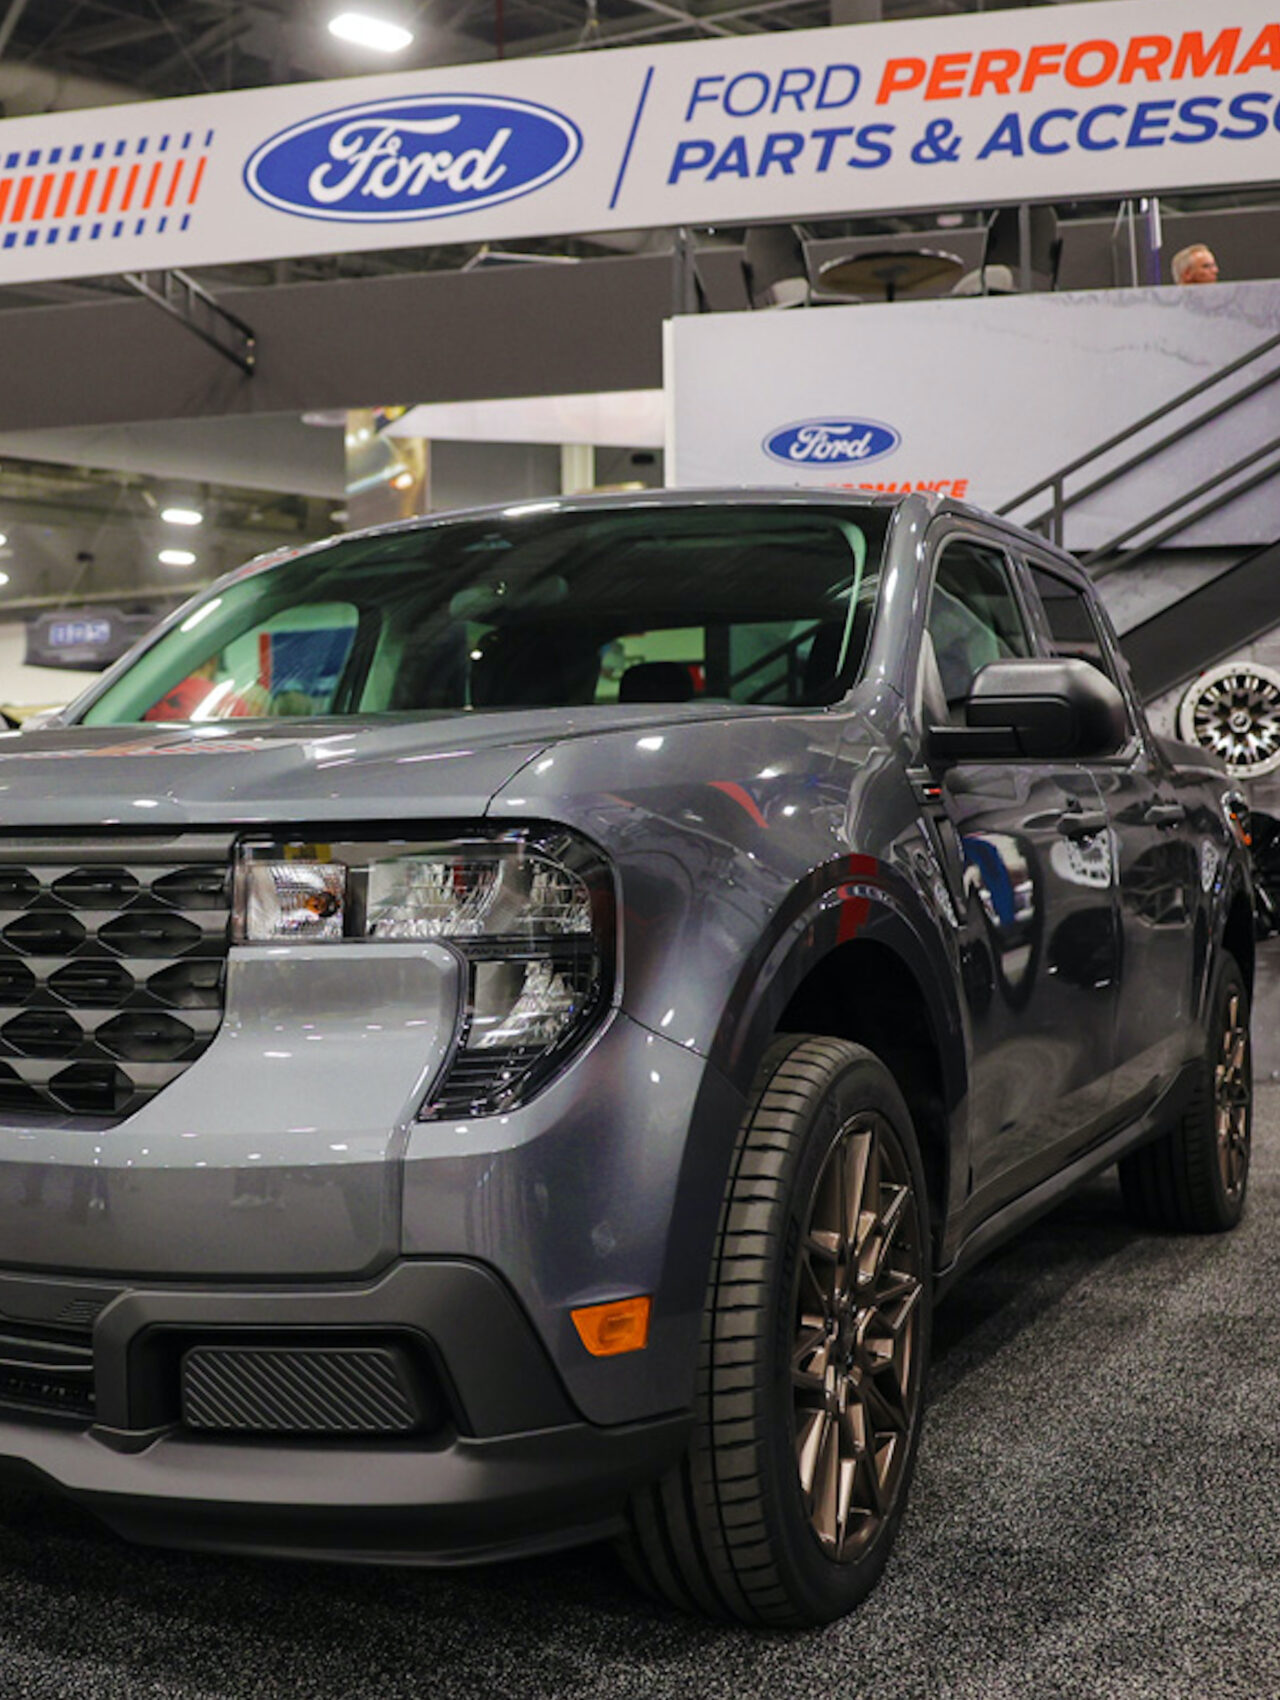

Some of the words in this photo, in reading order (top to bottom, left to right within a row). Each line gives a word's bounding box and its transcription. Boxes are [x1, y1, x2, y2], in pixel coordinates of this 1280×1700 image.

[685, 63, 861, 122] FORD
[875, 22, 1280, 106] PERFORMA
[309, 114, 512, 204] Ford
[667, 123, 896, 185] PARTS
[910, 118, 962, 165] &
[975, 91, 1280, 161] ACCESS
[789, 425, 872, 459] Ford
